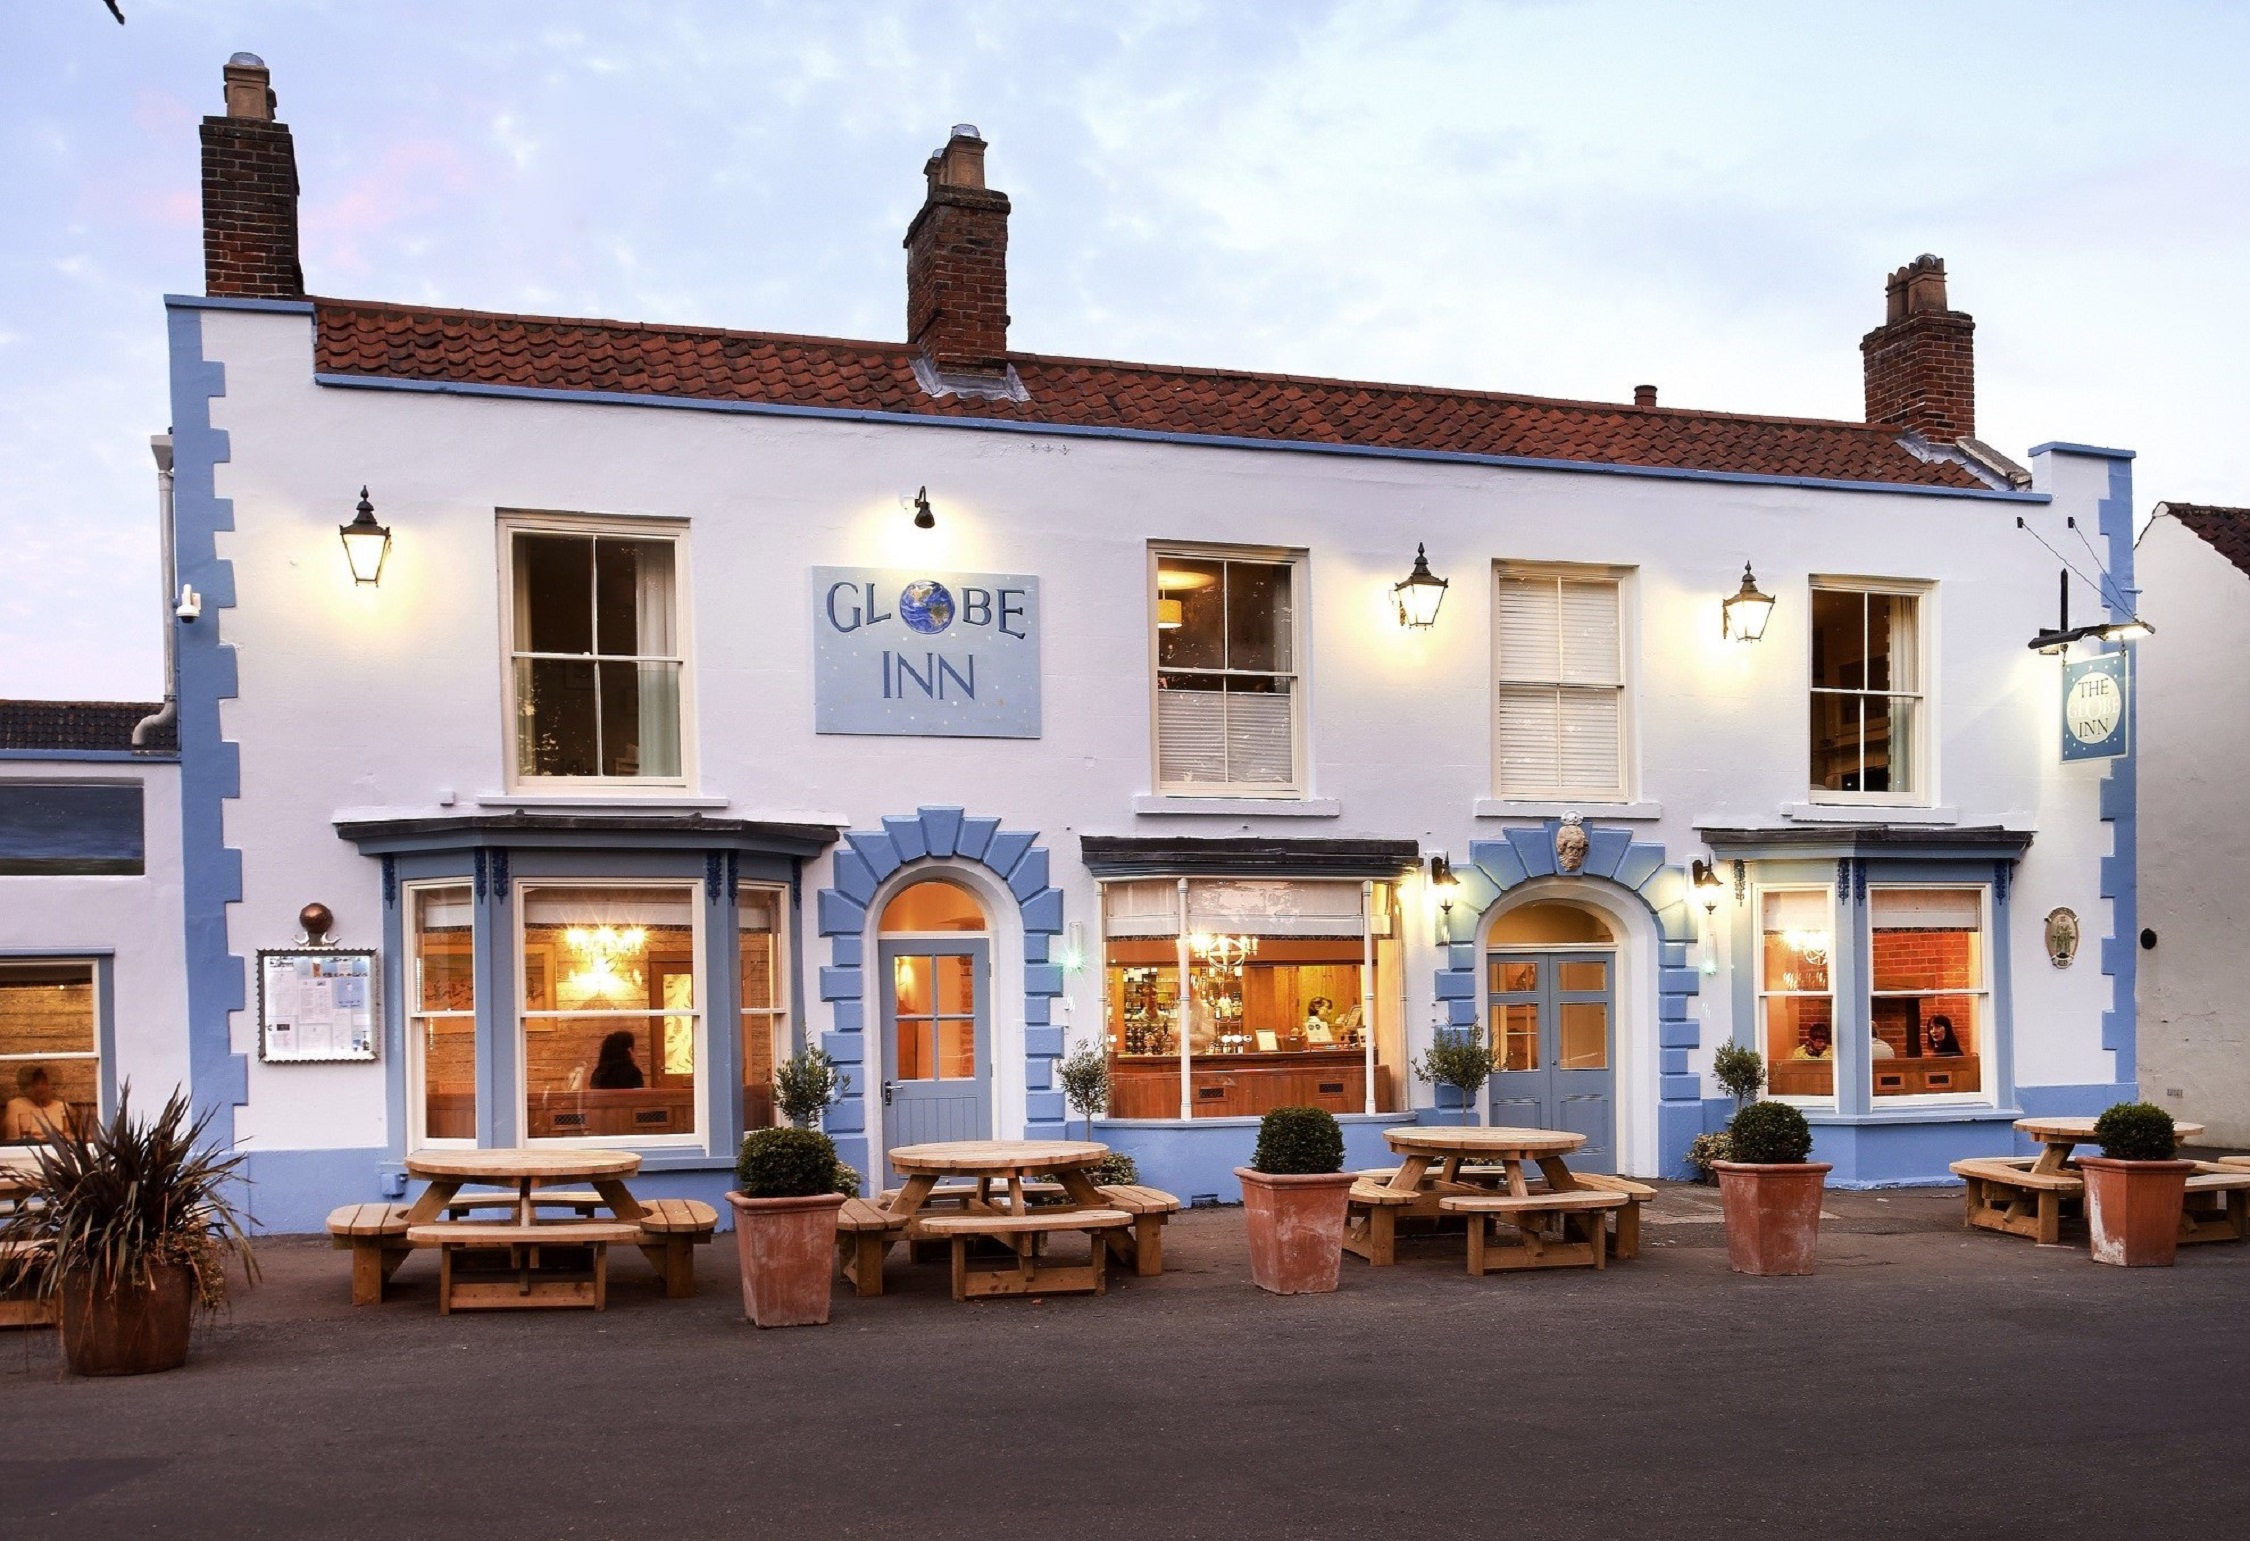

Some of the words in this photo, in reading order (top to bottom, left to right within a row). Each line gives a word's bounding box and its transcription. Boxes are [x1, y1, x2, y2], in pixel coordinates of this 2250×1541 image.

[827, 580, 1026, 640] GLOBE
[882, 650, 975, 701] INN
[2077, 678, 2109, 698] THE
[2068, 696, 2121, 719] GLOBE
[2078, 718, 2109, 738] INN
